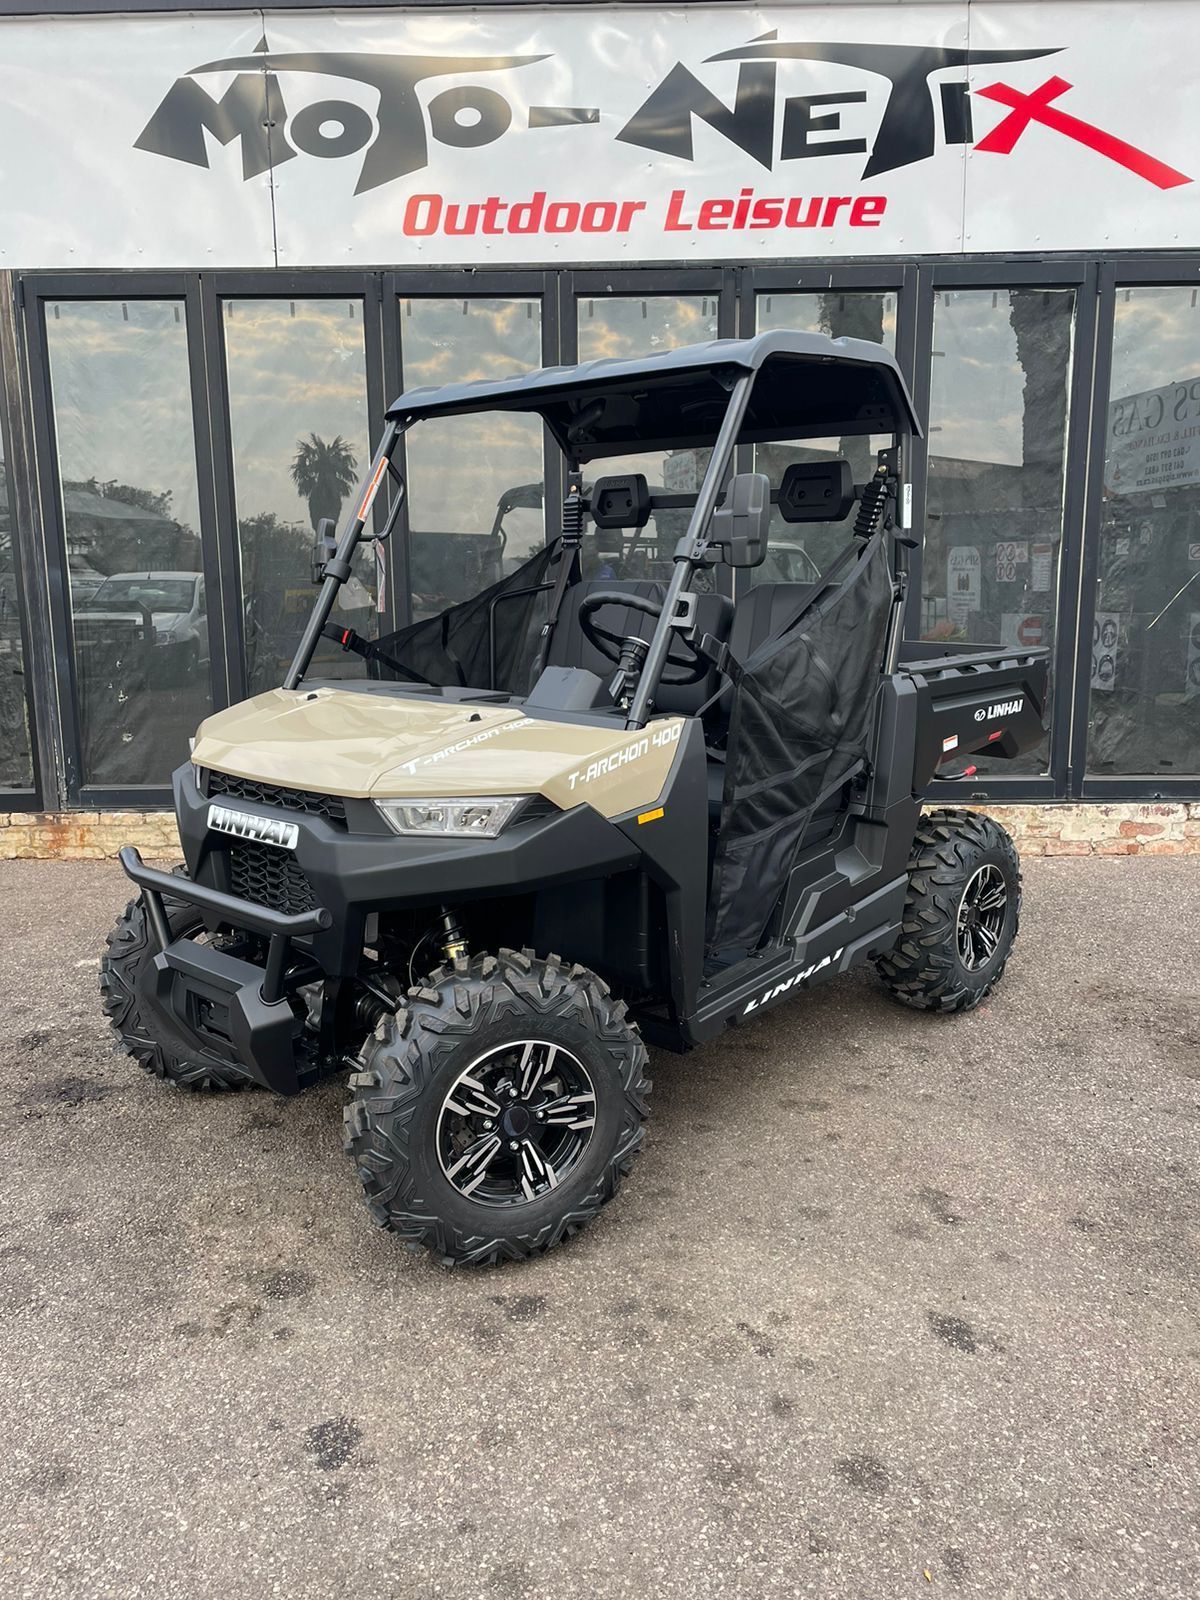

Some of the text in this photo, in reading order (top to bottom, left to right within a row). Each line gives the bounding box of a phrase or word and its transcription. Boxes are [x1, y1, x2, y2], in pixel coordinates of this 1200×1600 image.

[403, 189, 887, 236] Outdoor Leisure
[987, 699, 1024, 720] LINHAI
[402, 728, 500, 776] T-ARCHON
[568, 722, 682, 790] T-ARCHON 400
[209, 806, 296, 848] LINHAI
[743, 946, 844, 1015] LINHAI
